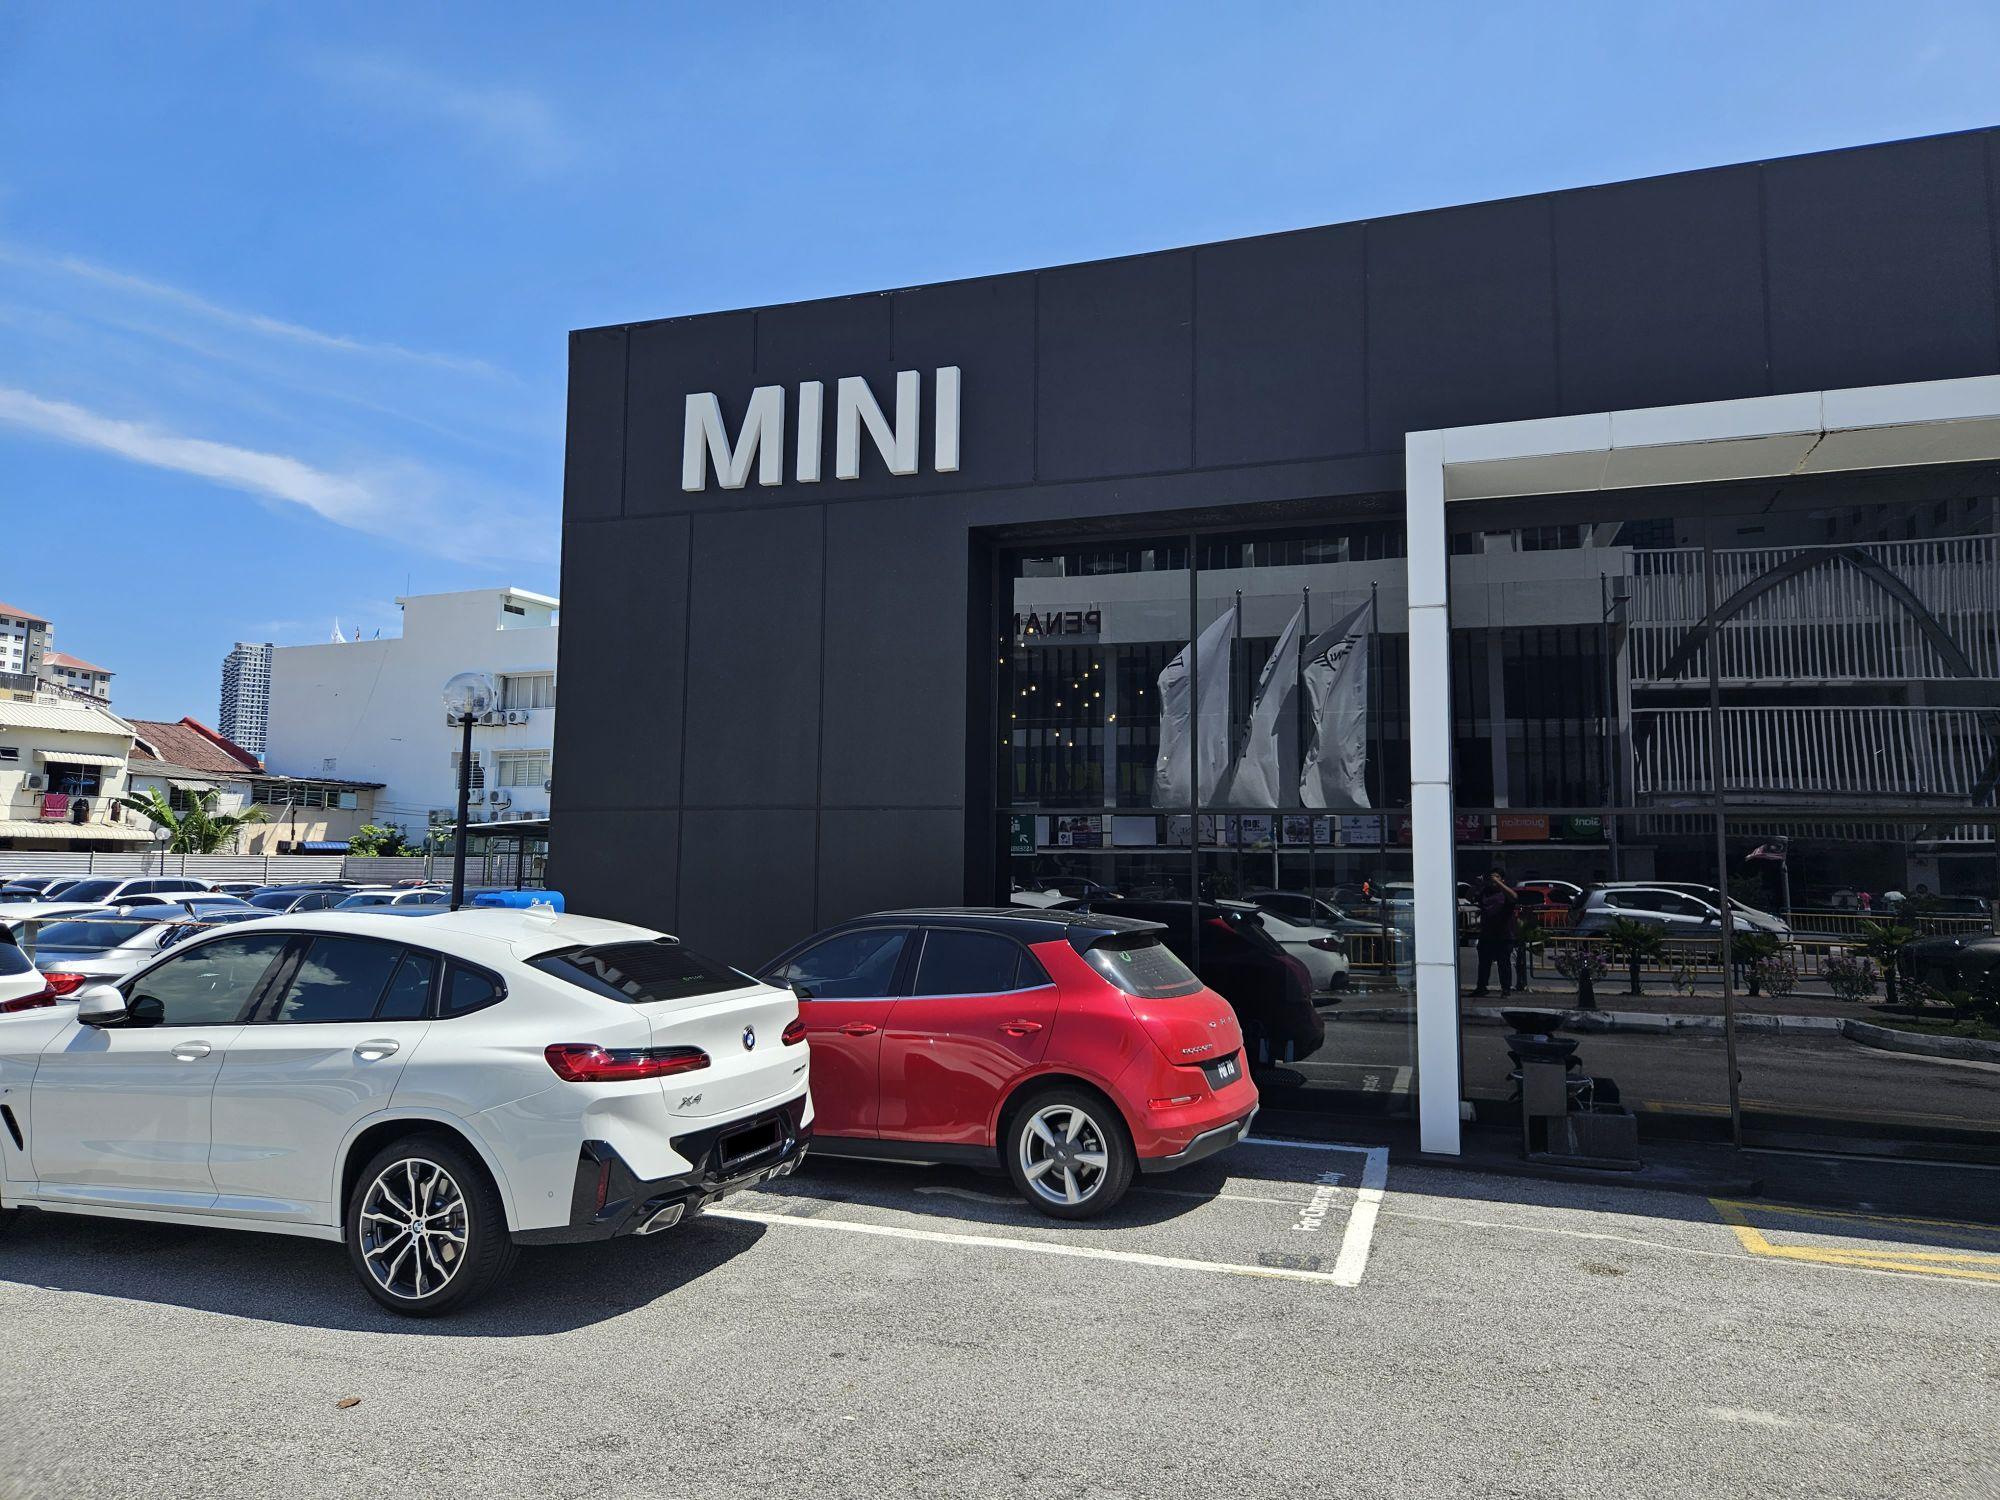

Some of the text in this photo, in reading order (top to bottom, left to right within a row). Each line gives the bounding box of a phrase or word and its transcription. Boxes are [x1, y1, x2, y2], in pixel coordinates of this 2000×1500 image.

[682, 366, 960, 491] MINI
[678, 1093, 703, 1110] X4
[1292, 1216, 1322, 1231] For
